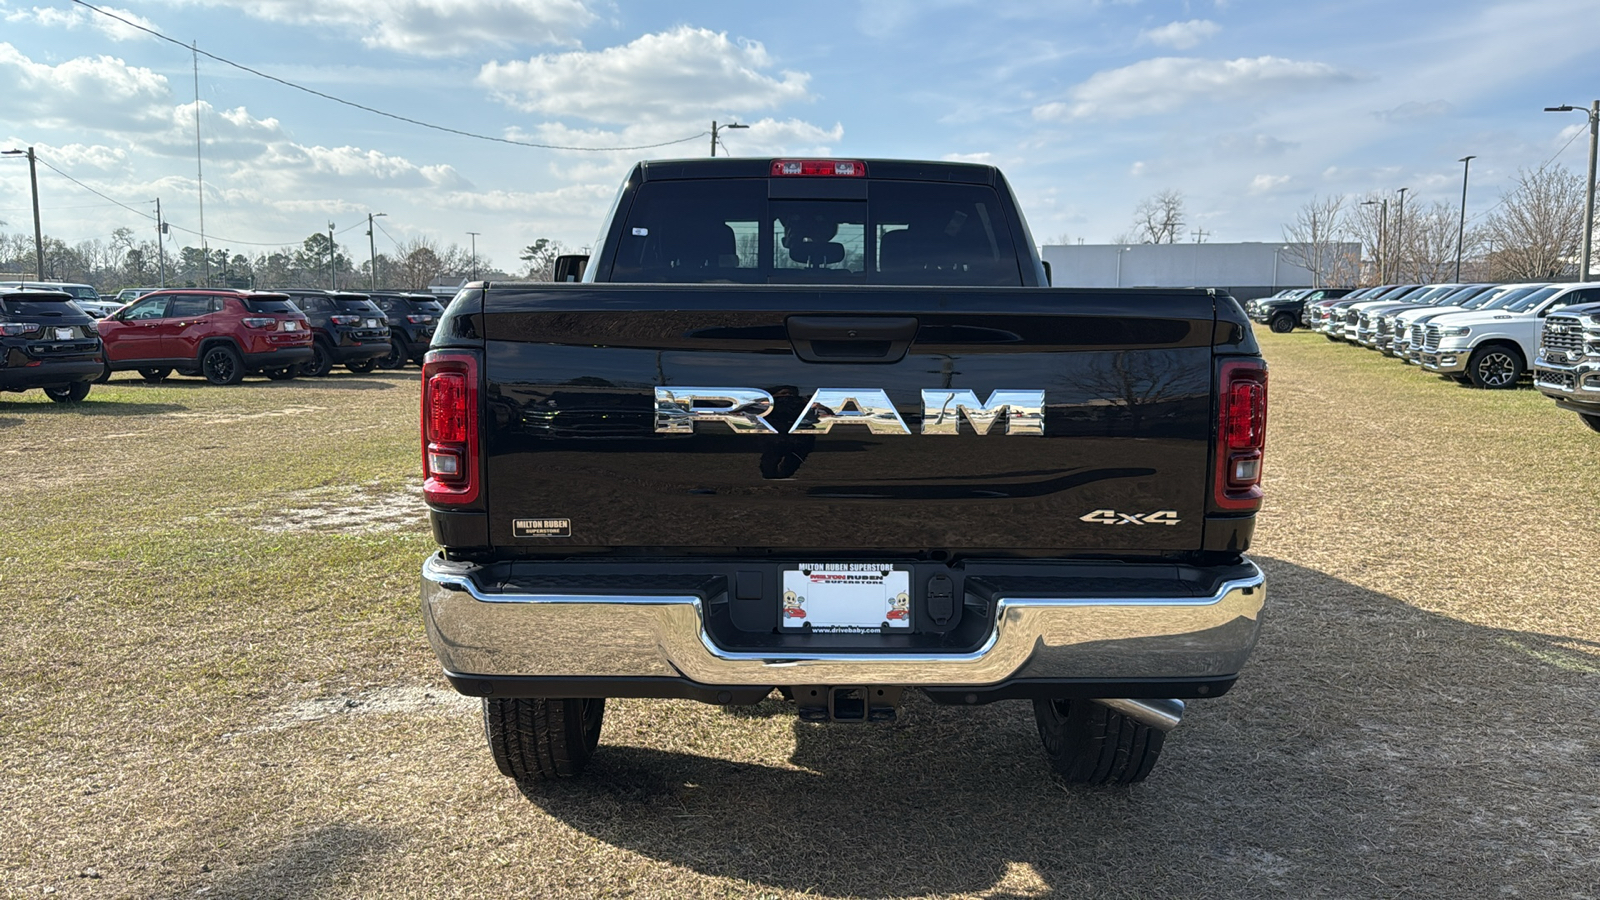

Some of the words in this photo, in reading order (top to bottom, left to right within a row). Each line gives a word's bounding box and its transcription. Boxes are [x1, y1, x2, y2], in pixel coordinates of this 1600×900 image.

[654, 386, 1045, 436] RAM
[1079, 510, 1182, 525] 4x4
[516, 520, 542, 528] MILTON
[544, 520, 568, 528] RUBEN
[798, 563, 824, 571] MILTON
[825, 563, 848, 571] RUBEN
[849, 563, 894, 571] SUPERSTORE
